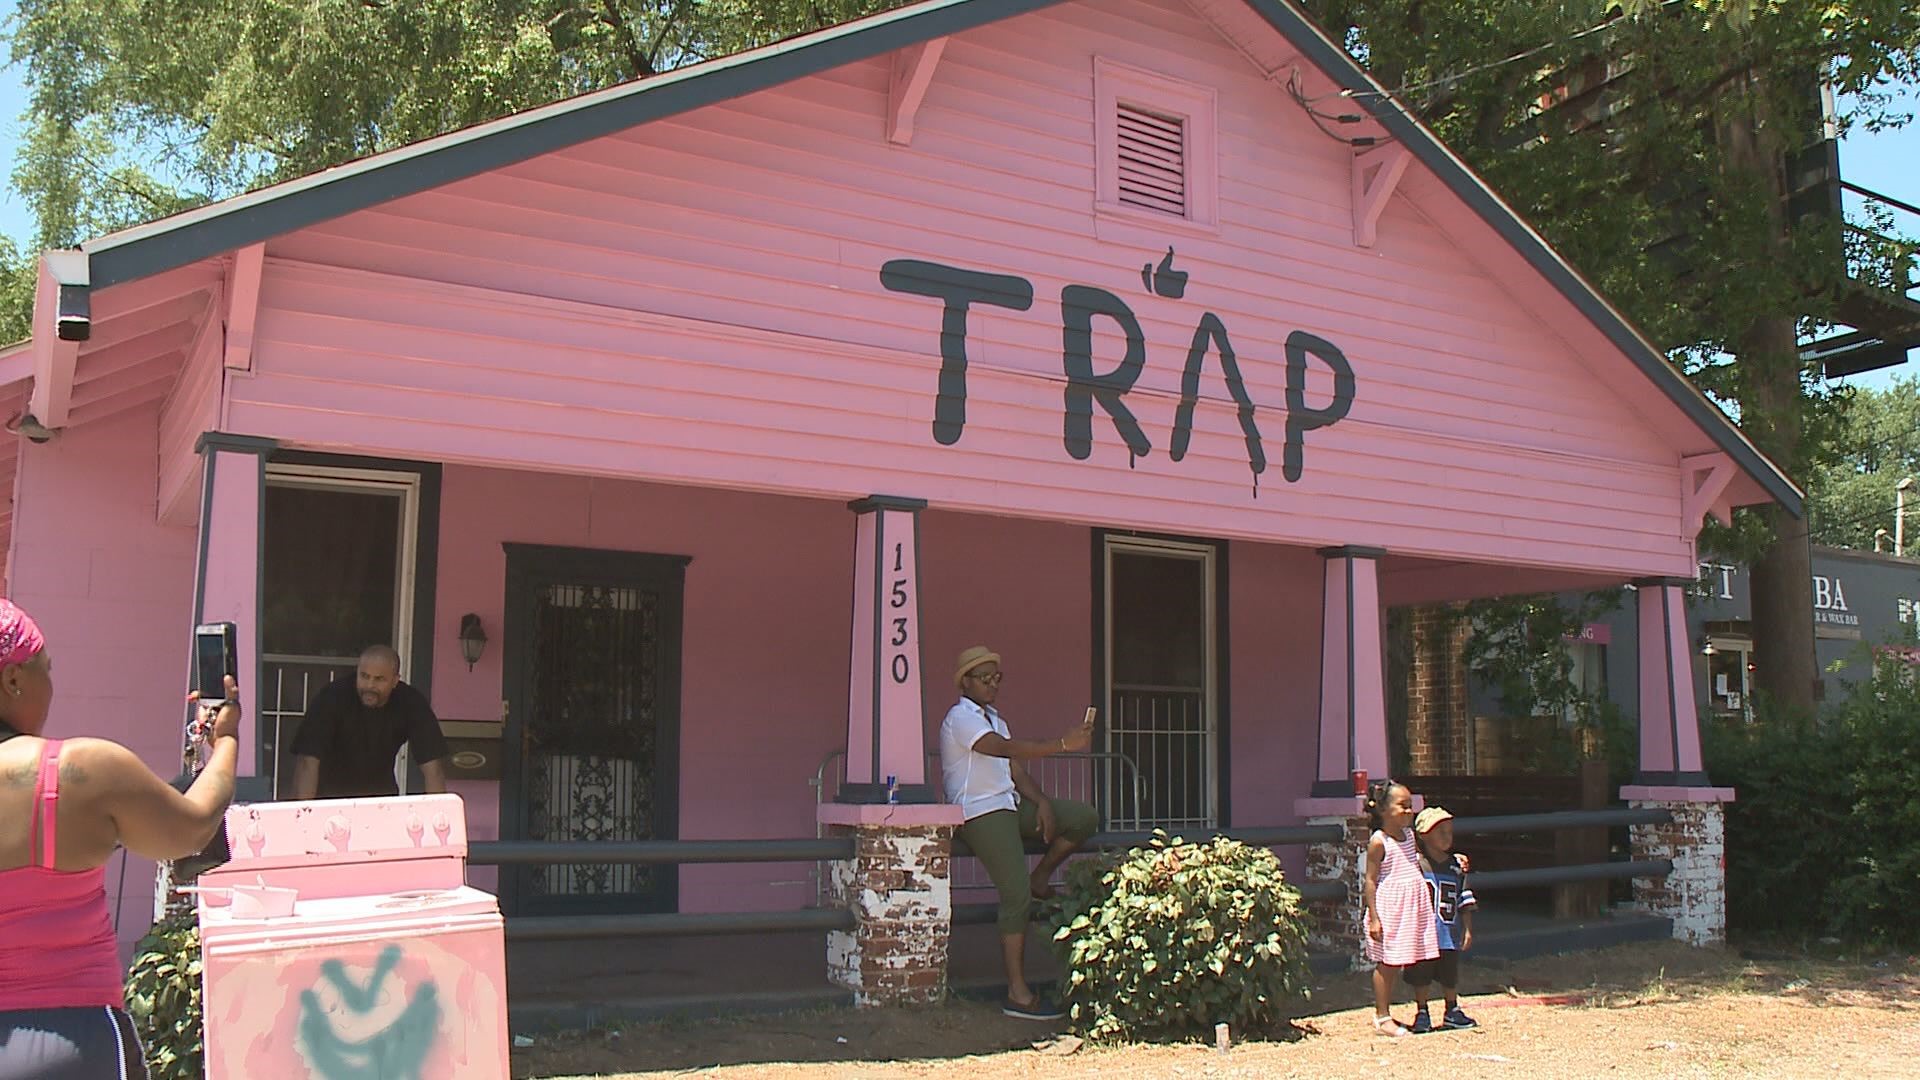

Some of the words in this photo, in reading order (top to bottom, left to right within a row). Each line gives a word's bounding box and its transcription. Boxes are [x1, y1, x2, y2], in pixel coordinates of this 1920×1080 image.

[880, 259, 1356, 484] TRAP
[890, 543, 909, 684] 1530
[1845, 614, 1859, 625] BAR
